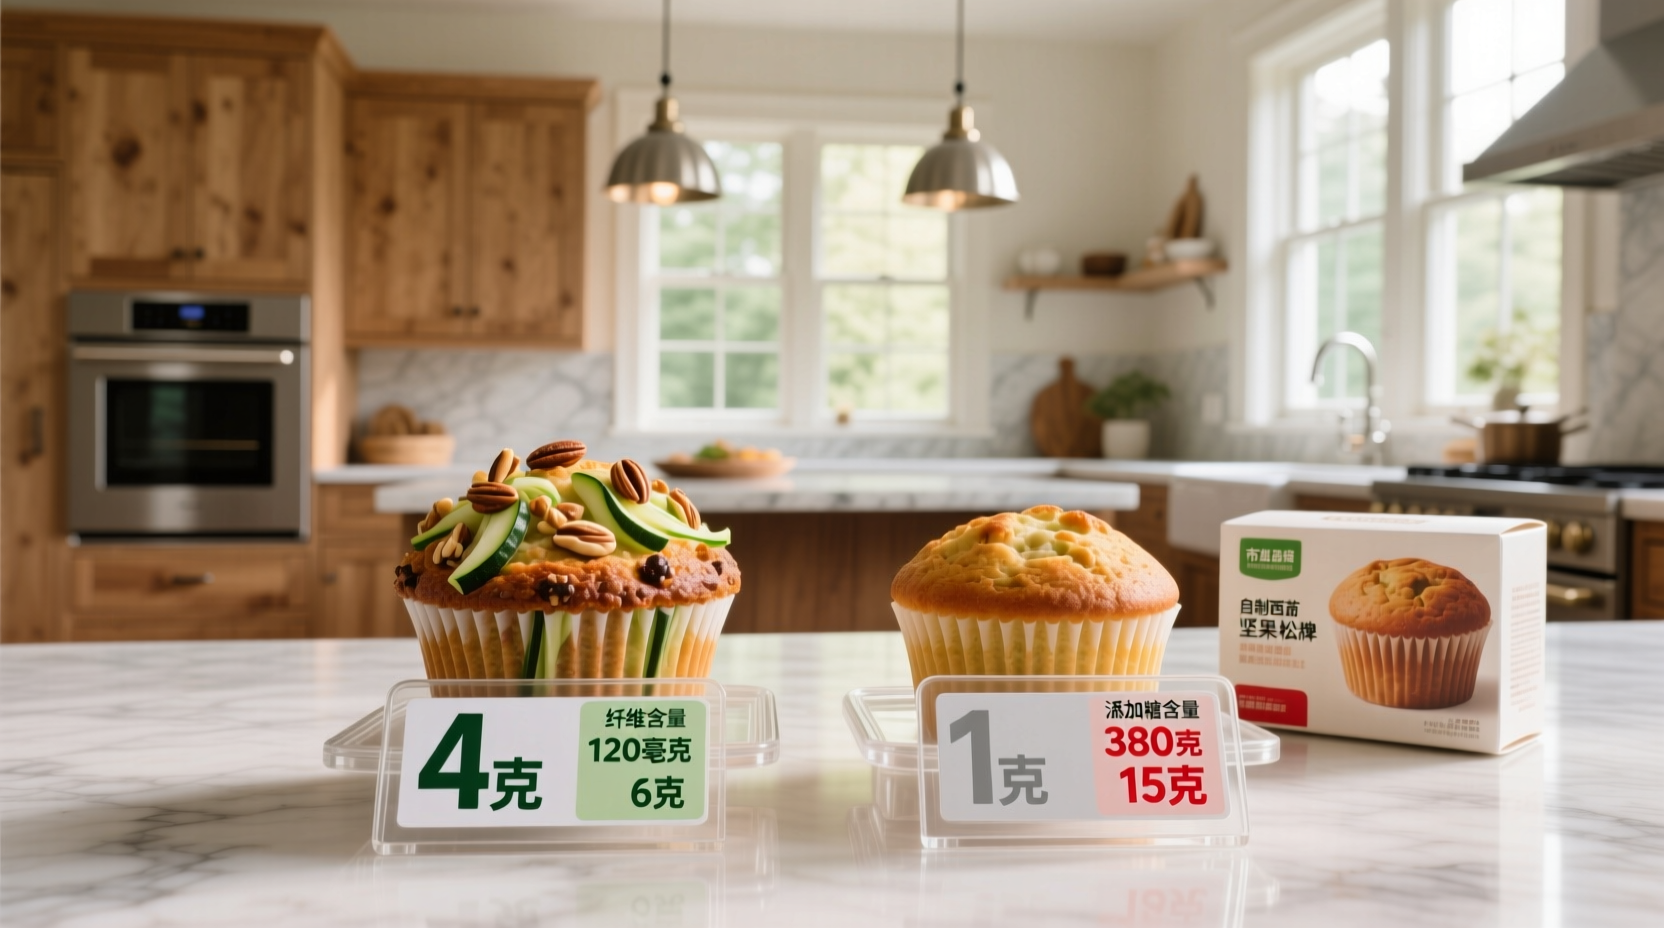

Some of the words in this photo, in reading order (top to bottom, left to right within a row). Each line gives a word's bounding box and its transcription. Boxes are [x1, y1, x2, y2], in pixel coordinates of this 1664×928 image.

[605, 707, 686, 730] 纤维含量
[588, 736, 692, 764] 120毫克
[949, 709, 1049, 806] 1克
[1104, 725, 1203, 757] 380克
[418, 712, 543, 811] 4克
[630, 775, 685, 810] 6克
[1119, 765, 1208, 806] 15克
